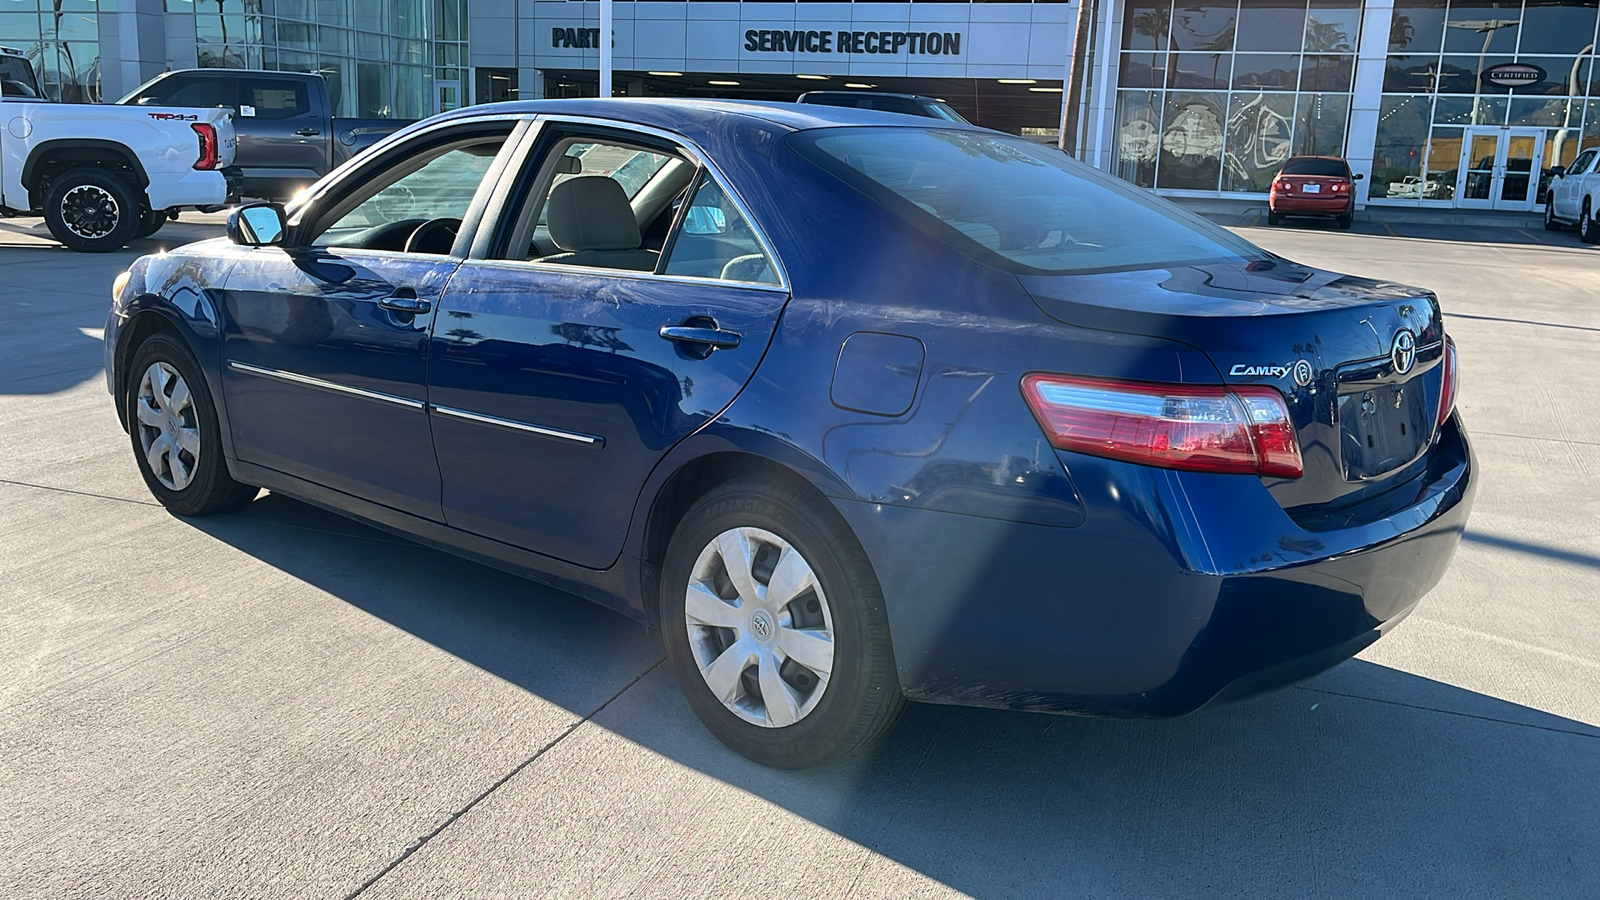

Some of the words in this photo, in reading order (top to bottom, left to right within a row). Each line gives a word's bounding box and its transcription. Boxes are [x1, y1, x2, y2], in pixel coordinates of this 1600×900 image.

[552, 27, 614, 48] PART
[744, 29, 832, 53] SERVICE
[836, 31, 961, 55] RECEPTION
